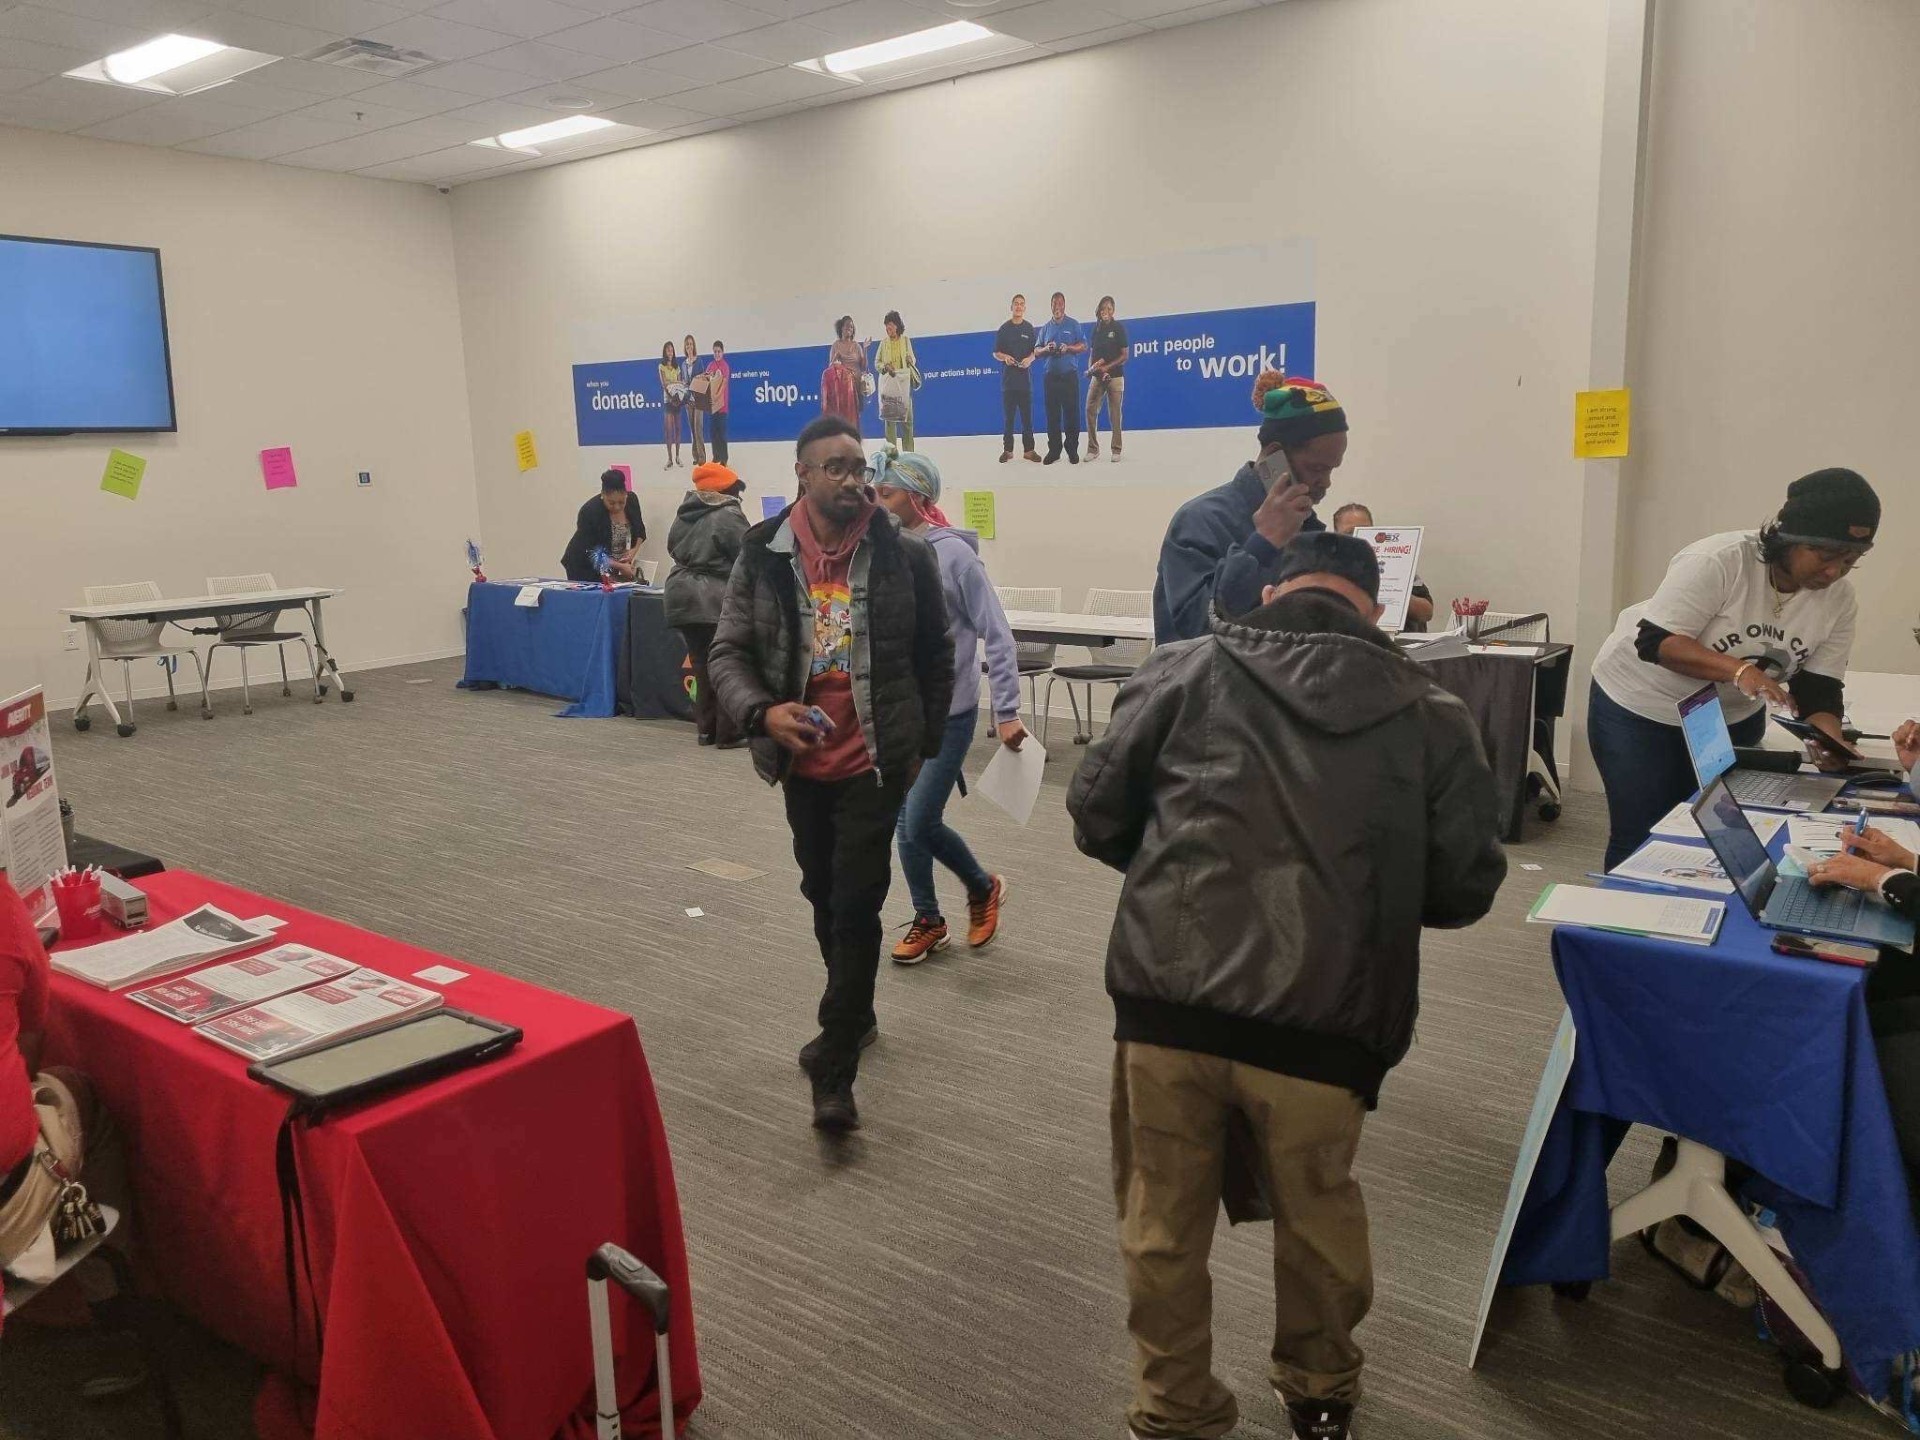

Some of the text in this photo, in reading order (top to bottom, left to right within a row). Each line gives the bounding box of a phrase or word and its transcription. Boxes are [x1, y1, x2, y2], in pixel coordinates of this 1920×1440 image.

[1133, 334, 1215, 357] put people
[1176, 343, 1286, 379] to work!
[742, 370, 758, 378] when
[759, 370, 770, 378] you
[924, 371, 939, 380] your
[940, 368, 965, 378] actions
[966, 367, 982, 377] help
[586, 380, 599, 388] when
[755, 380, 818, 407] shop...
[592, 390, 661, 410] donate...
[1384, 545, 1412, 555] HIRING!
[1712, 633, 1742, 653] UR
[1746, 623, 1784, 641] OWN
